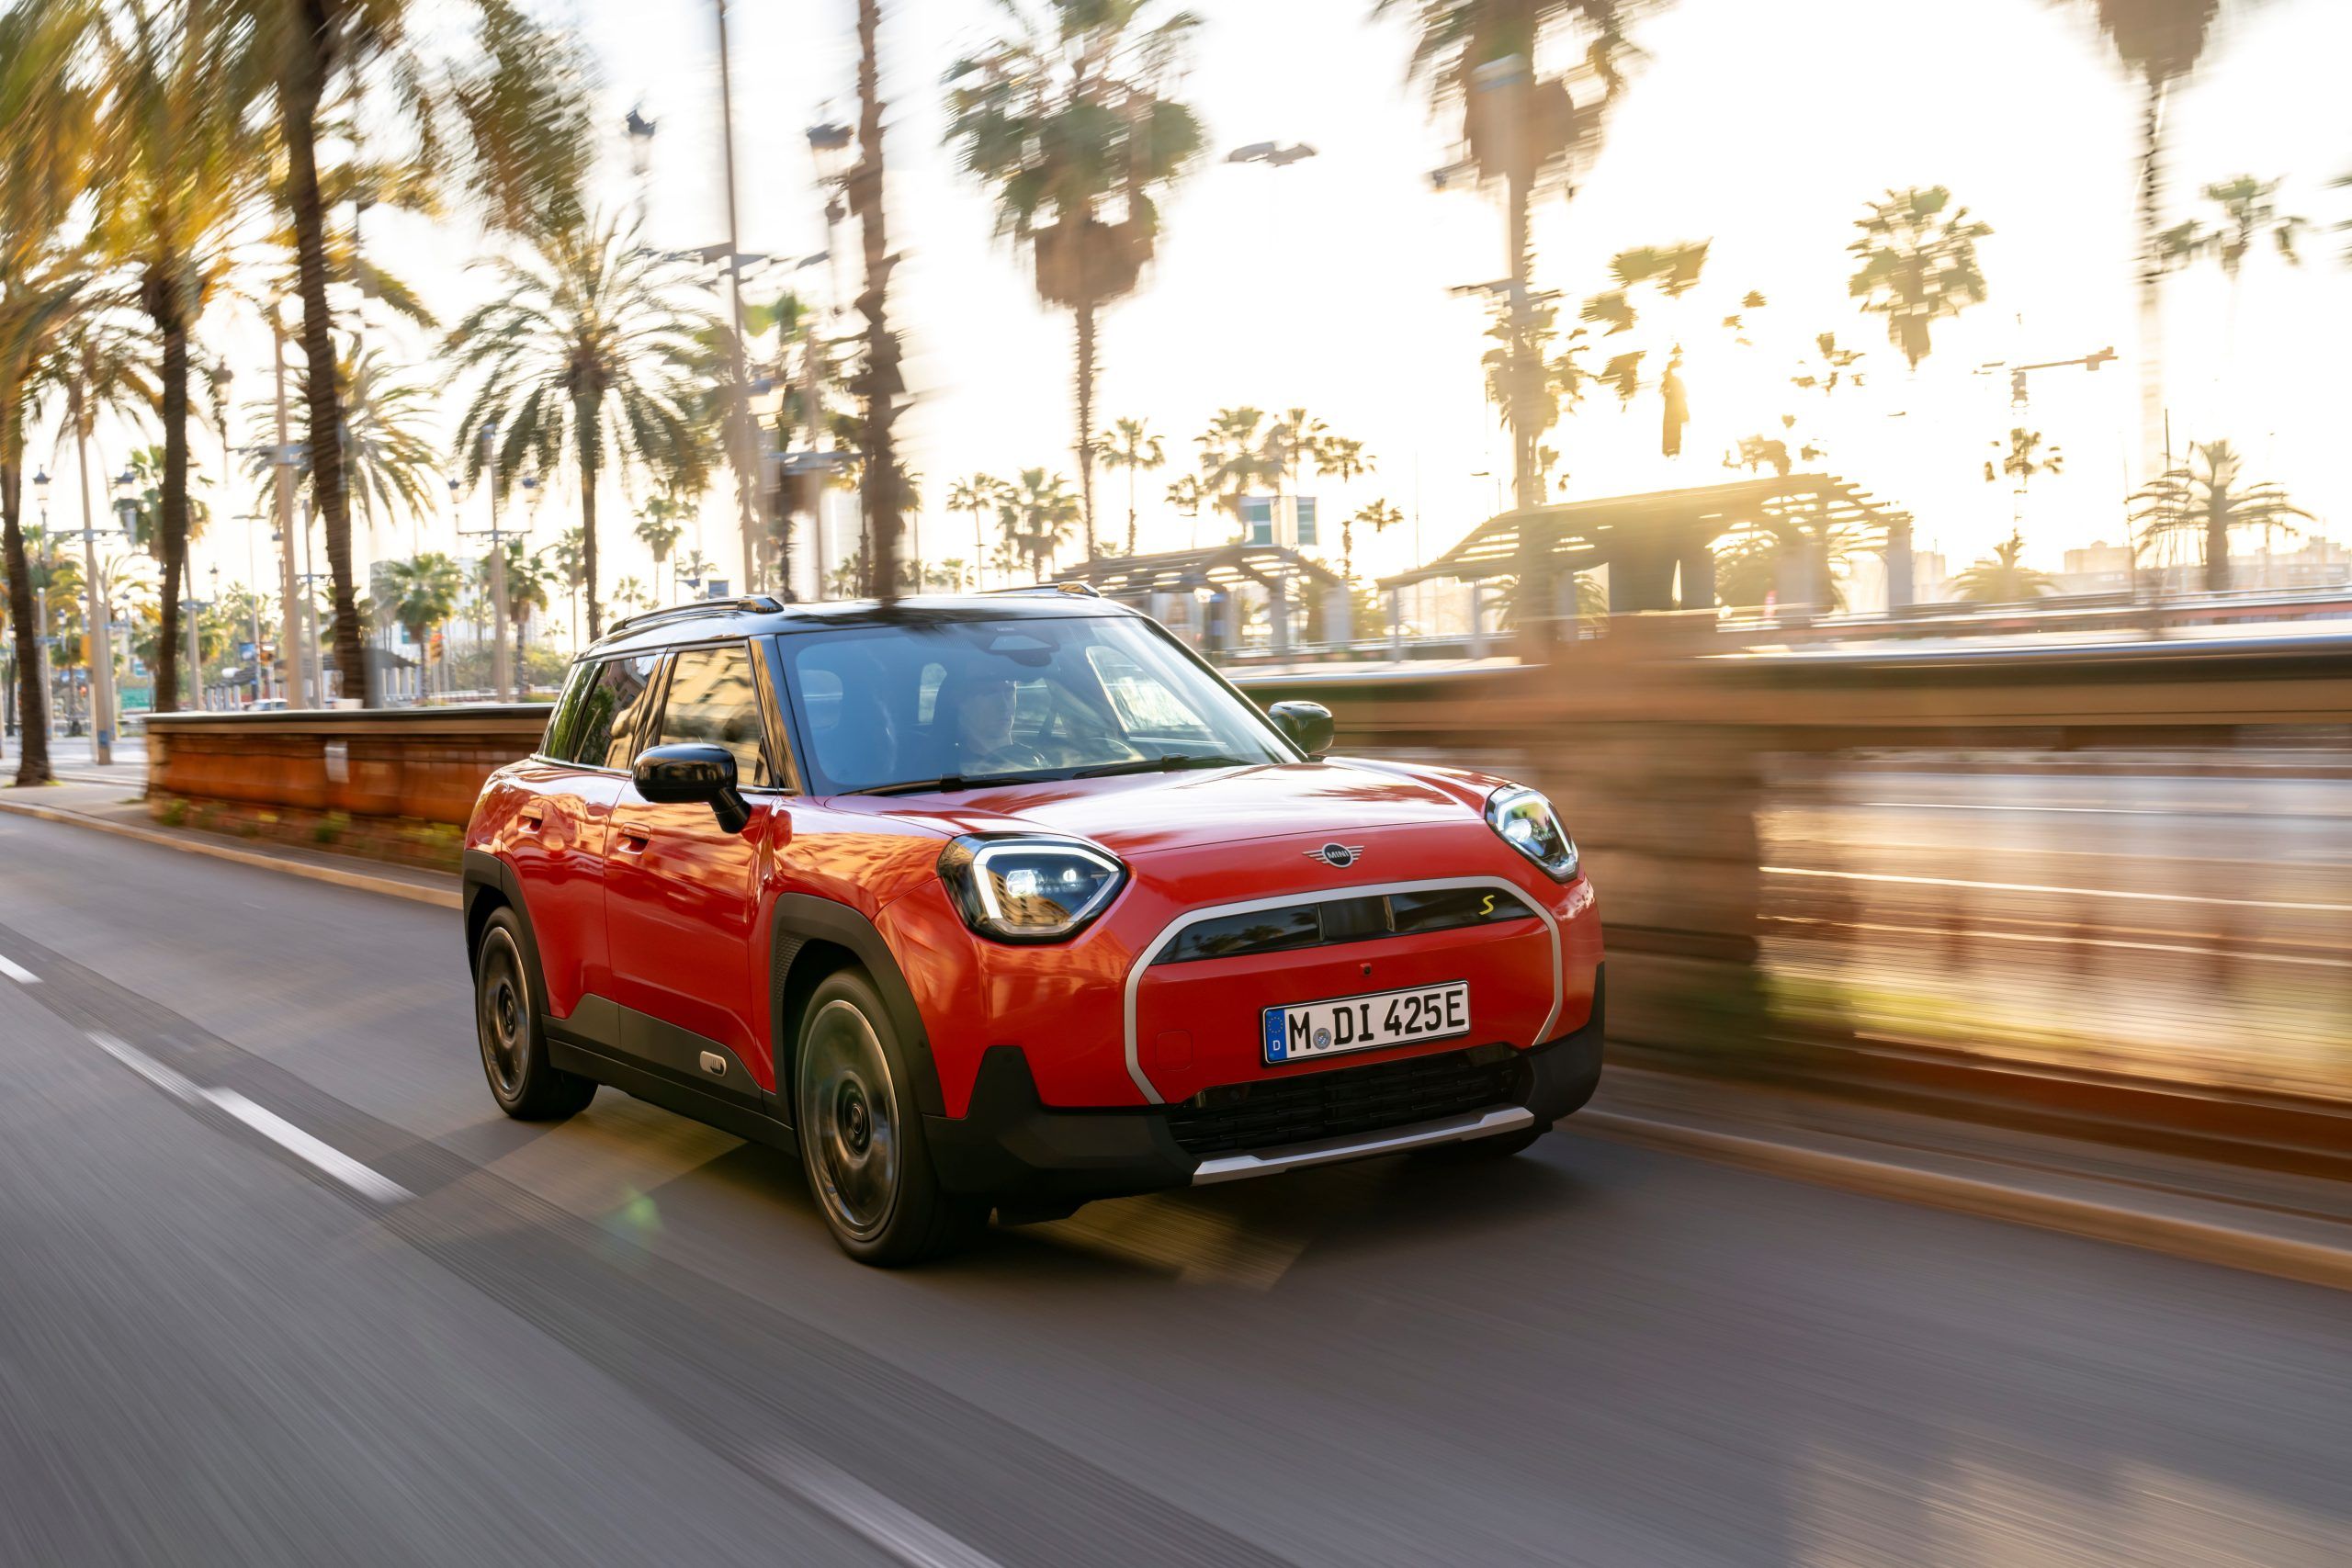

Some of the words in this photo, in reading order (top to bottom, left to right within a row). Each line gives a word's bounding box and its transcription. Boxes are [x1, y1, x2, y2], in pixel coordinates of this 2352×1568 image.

[1326, 850, 1350, 859] MINI
[1478, 895, 1495, 915] S
[1288, 1011, 1311, 1051] M
[1332, 1004, 1374, 1045] DI
[1384, 989, 1465, 1036] 425E
[1272, 1040, 1281, 1051] D
